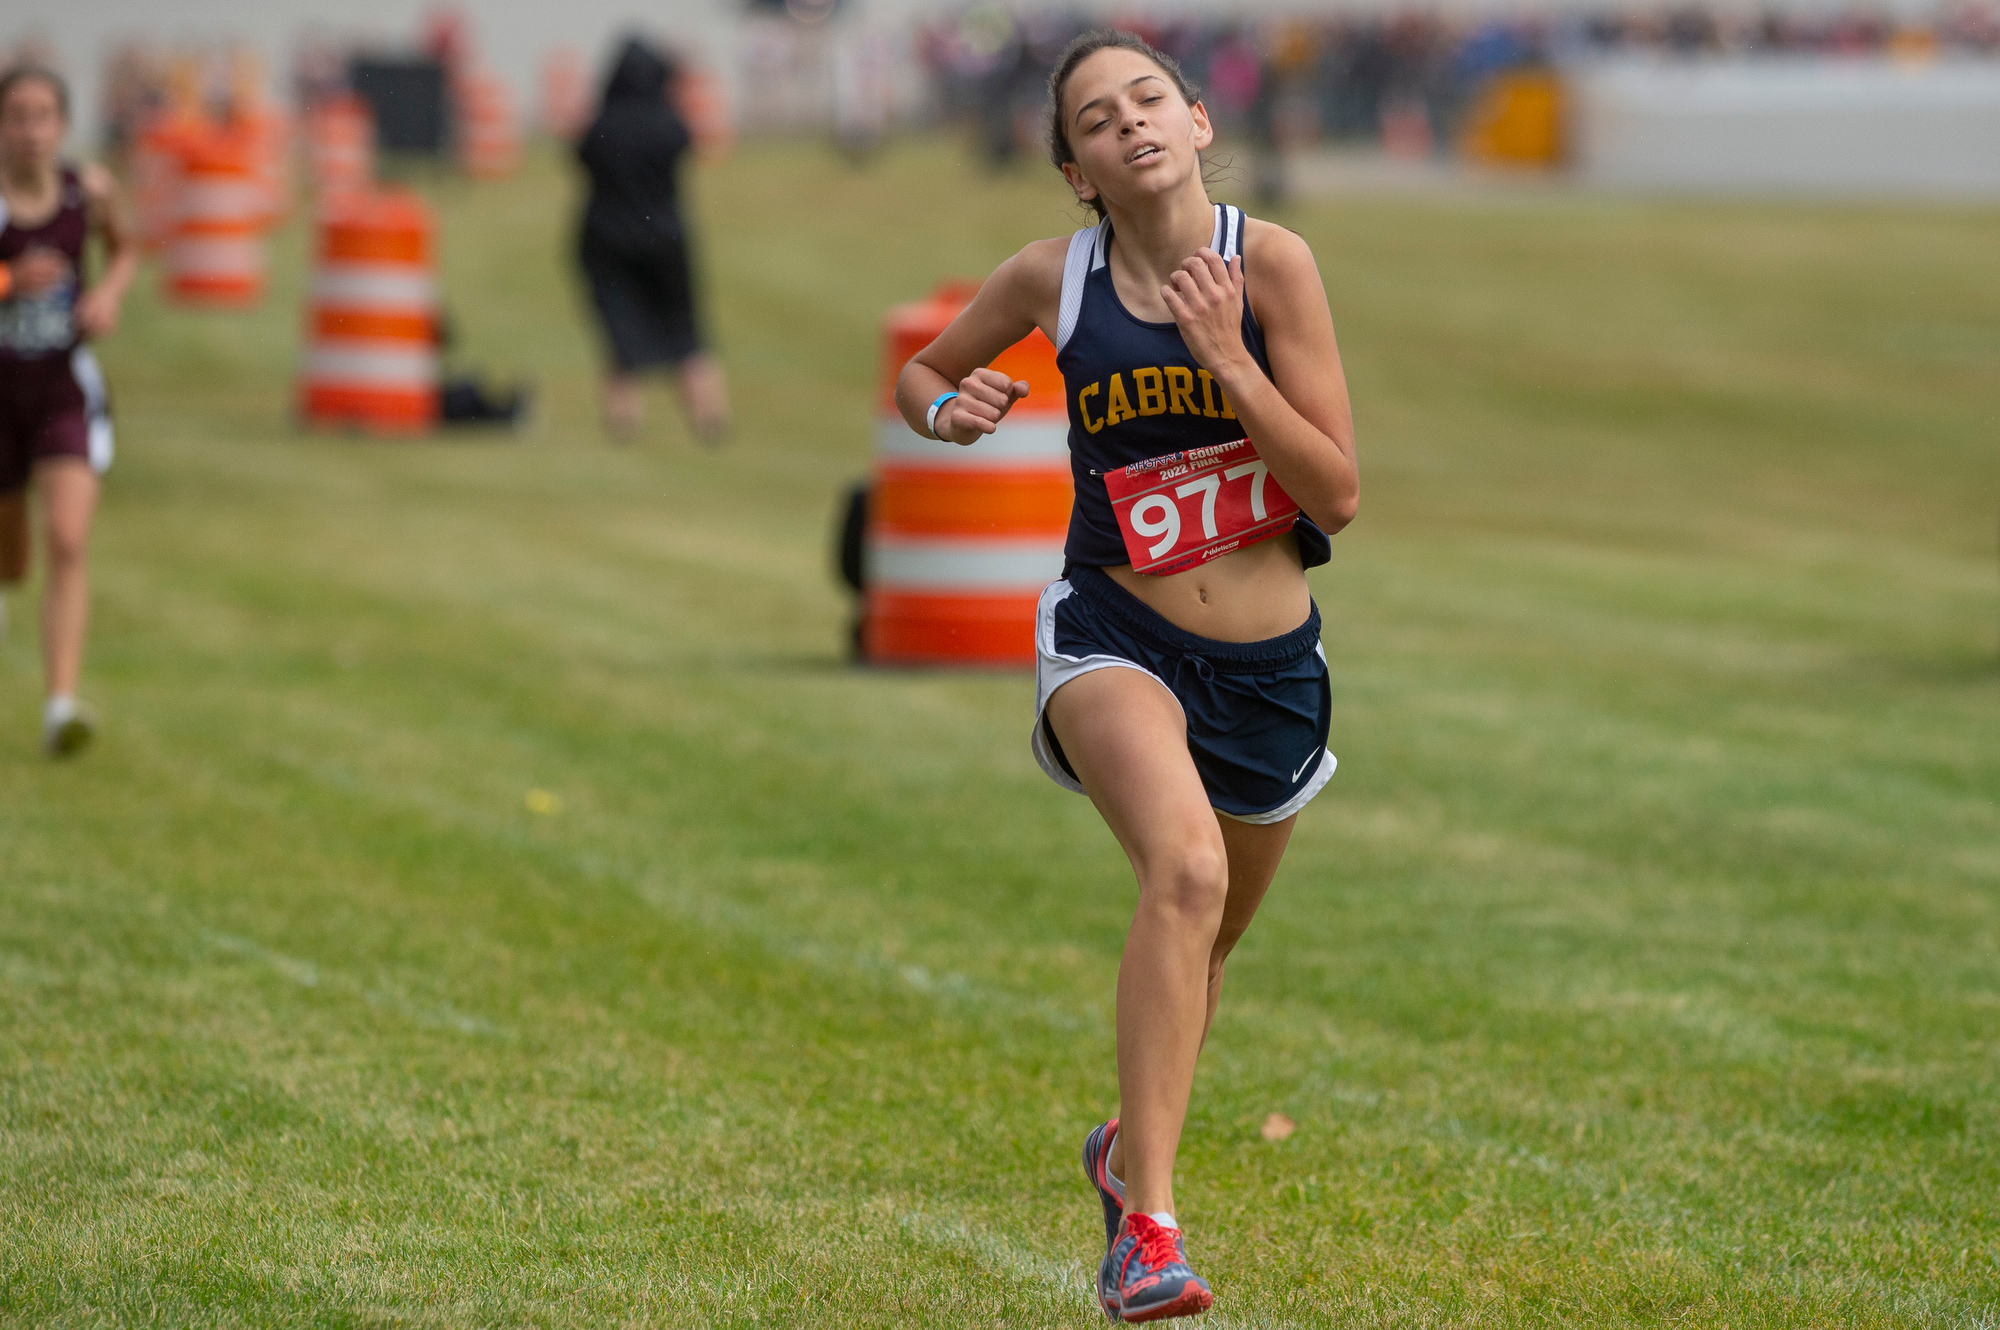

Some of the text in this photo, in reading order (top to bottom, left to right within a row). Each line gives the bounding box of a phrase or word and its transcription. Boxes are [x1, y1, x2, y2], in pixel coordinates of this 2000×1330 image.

[1188, 439, 1245, 461] COUNTRY
[1160, 464, 1189, 480] 2022
[1190, 456, 1223, 471] FINAL
[1130, 459, 1269, 560] 977
[1167, 564, 1176, 572] ON
[1176, 557, 1195, 569] FRONT
